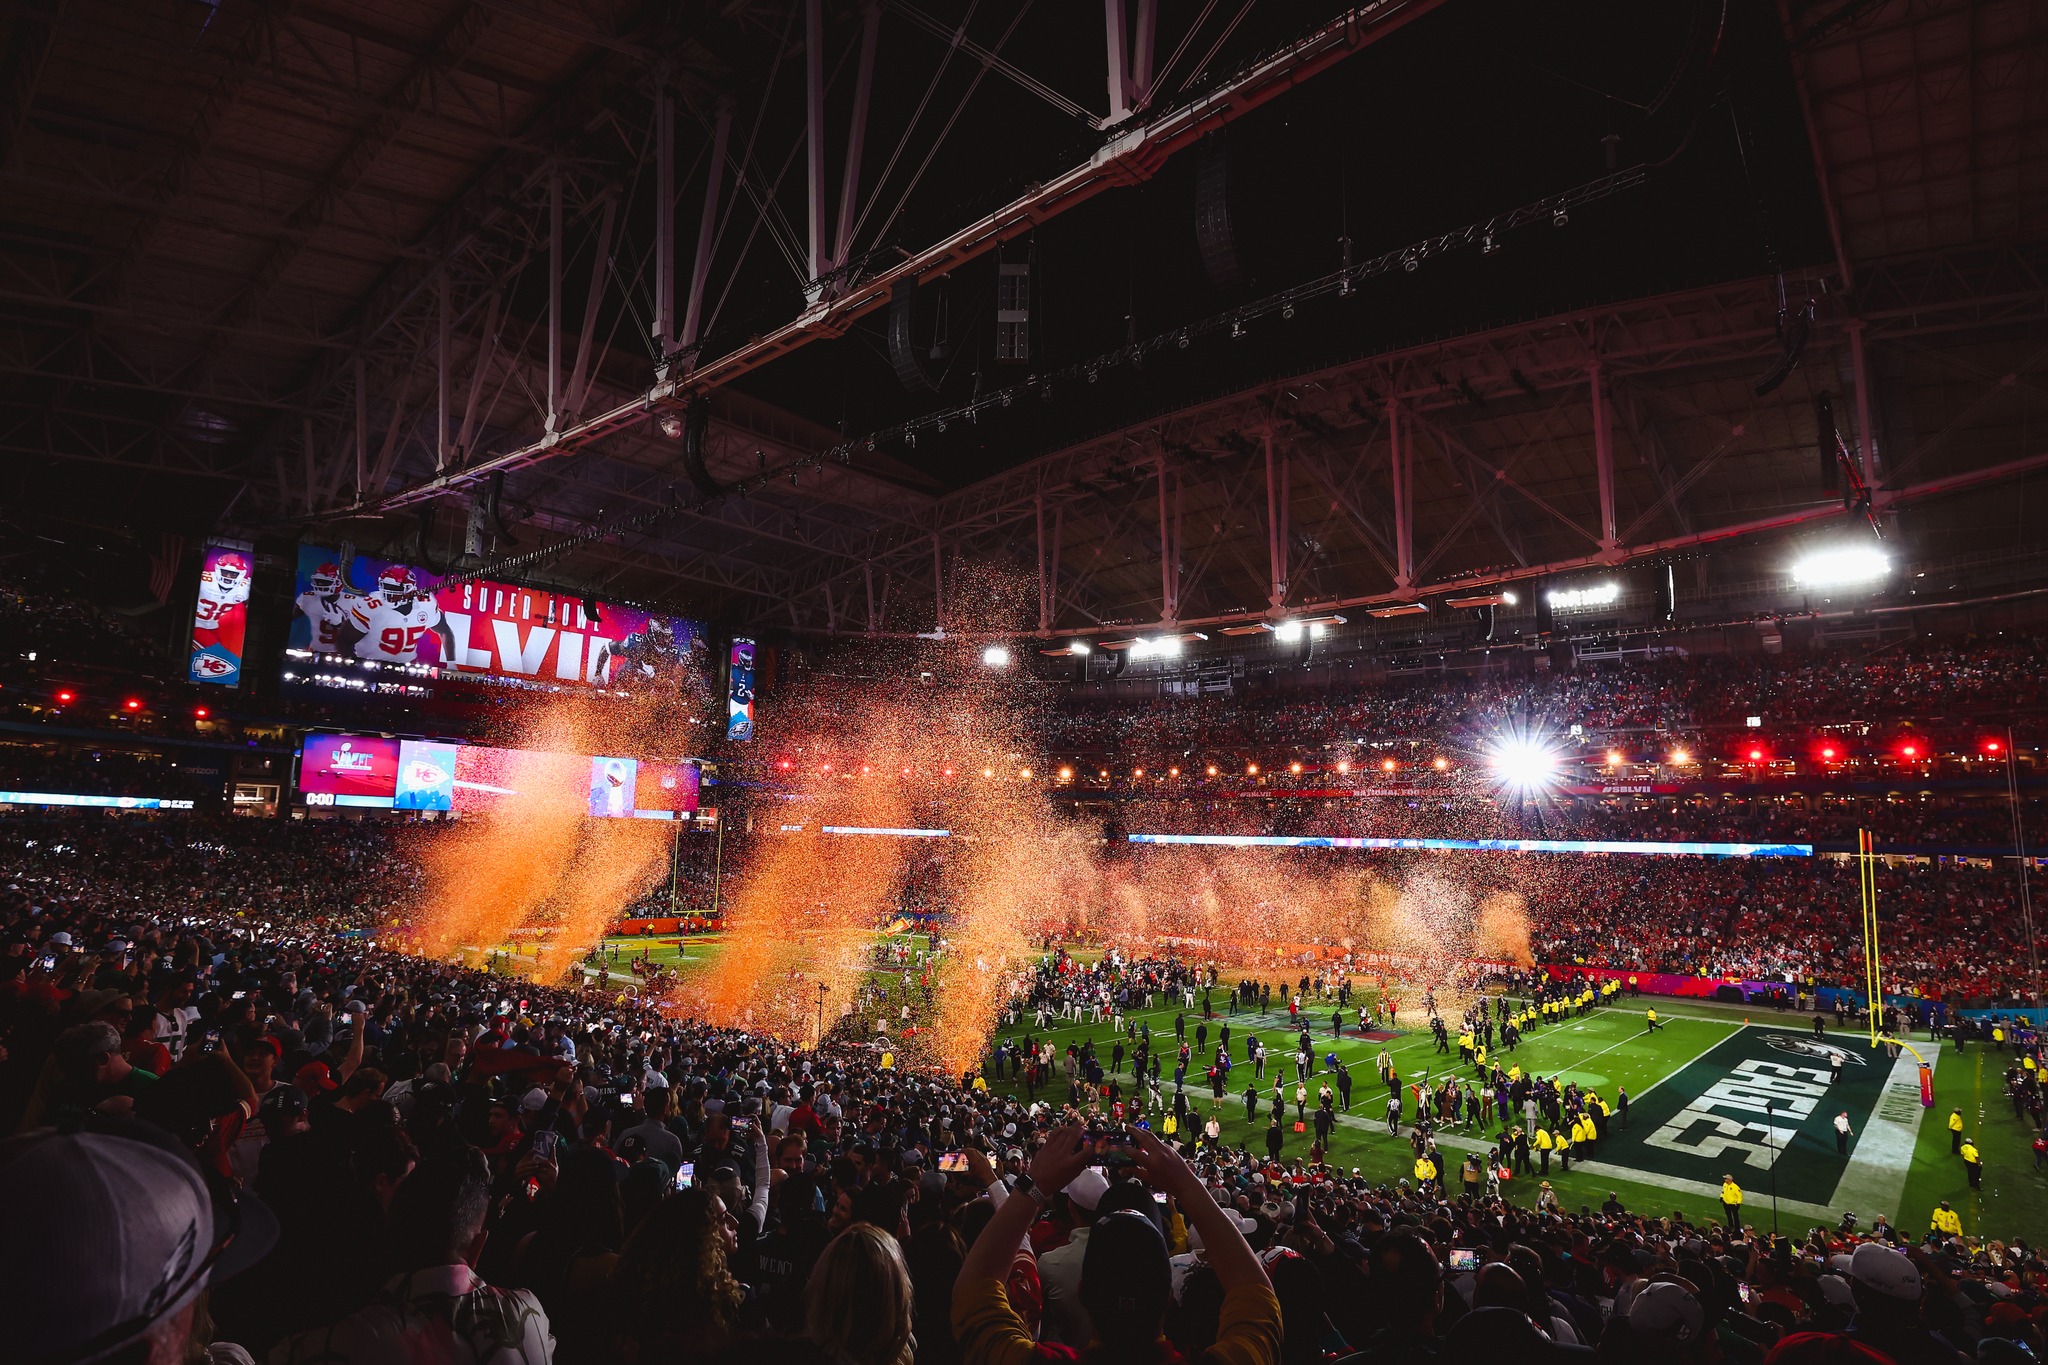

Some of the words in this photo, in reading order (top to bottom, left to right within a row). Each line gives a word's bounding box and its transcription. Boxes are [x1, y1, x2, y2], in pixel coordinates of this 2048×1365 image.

[463, 584, 532, 620] SUPER
[548, 596, 602, 633] BOWL
[379, 625, 427, 656] 95
[439, 611, 613, 686] LVII
[203, 659, 227, 674] KC
[737, 683, 746, 697] 2
[415, 768, 438, 783] KC
[1353, 788, 1399, 797] NATIONAL
[1602, 786, 1651, 794] #SBLVII
[306, 792, 334, 806] 0:00
[598, 1087, 617, 1096] KINS
[1643, 1058, 1834, 1172] EAGLES
